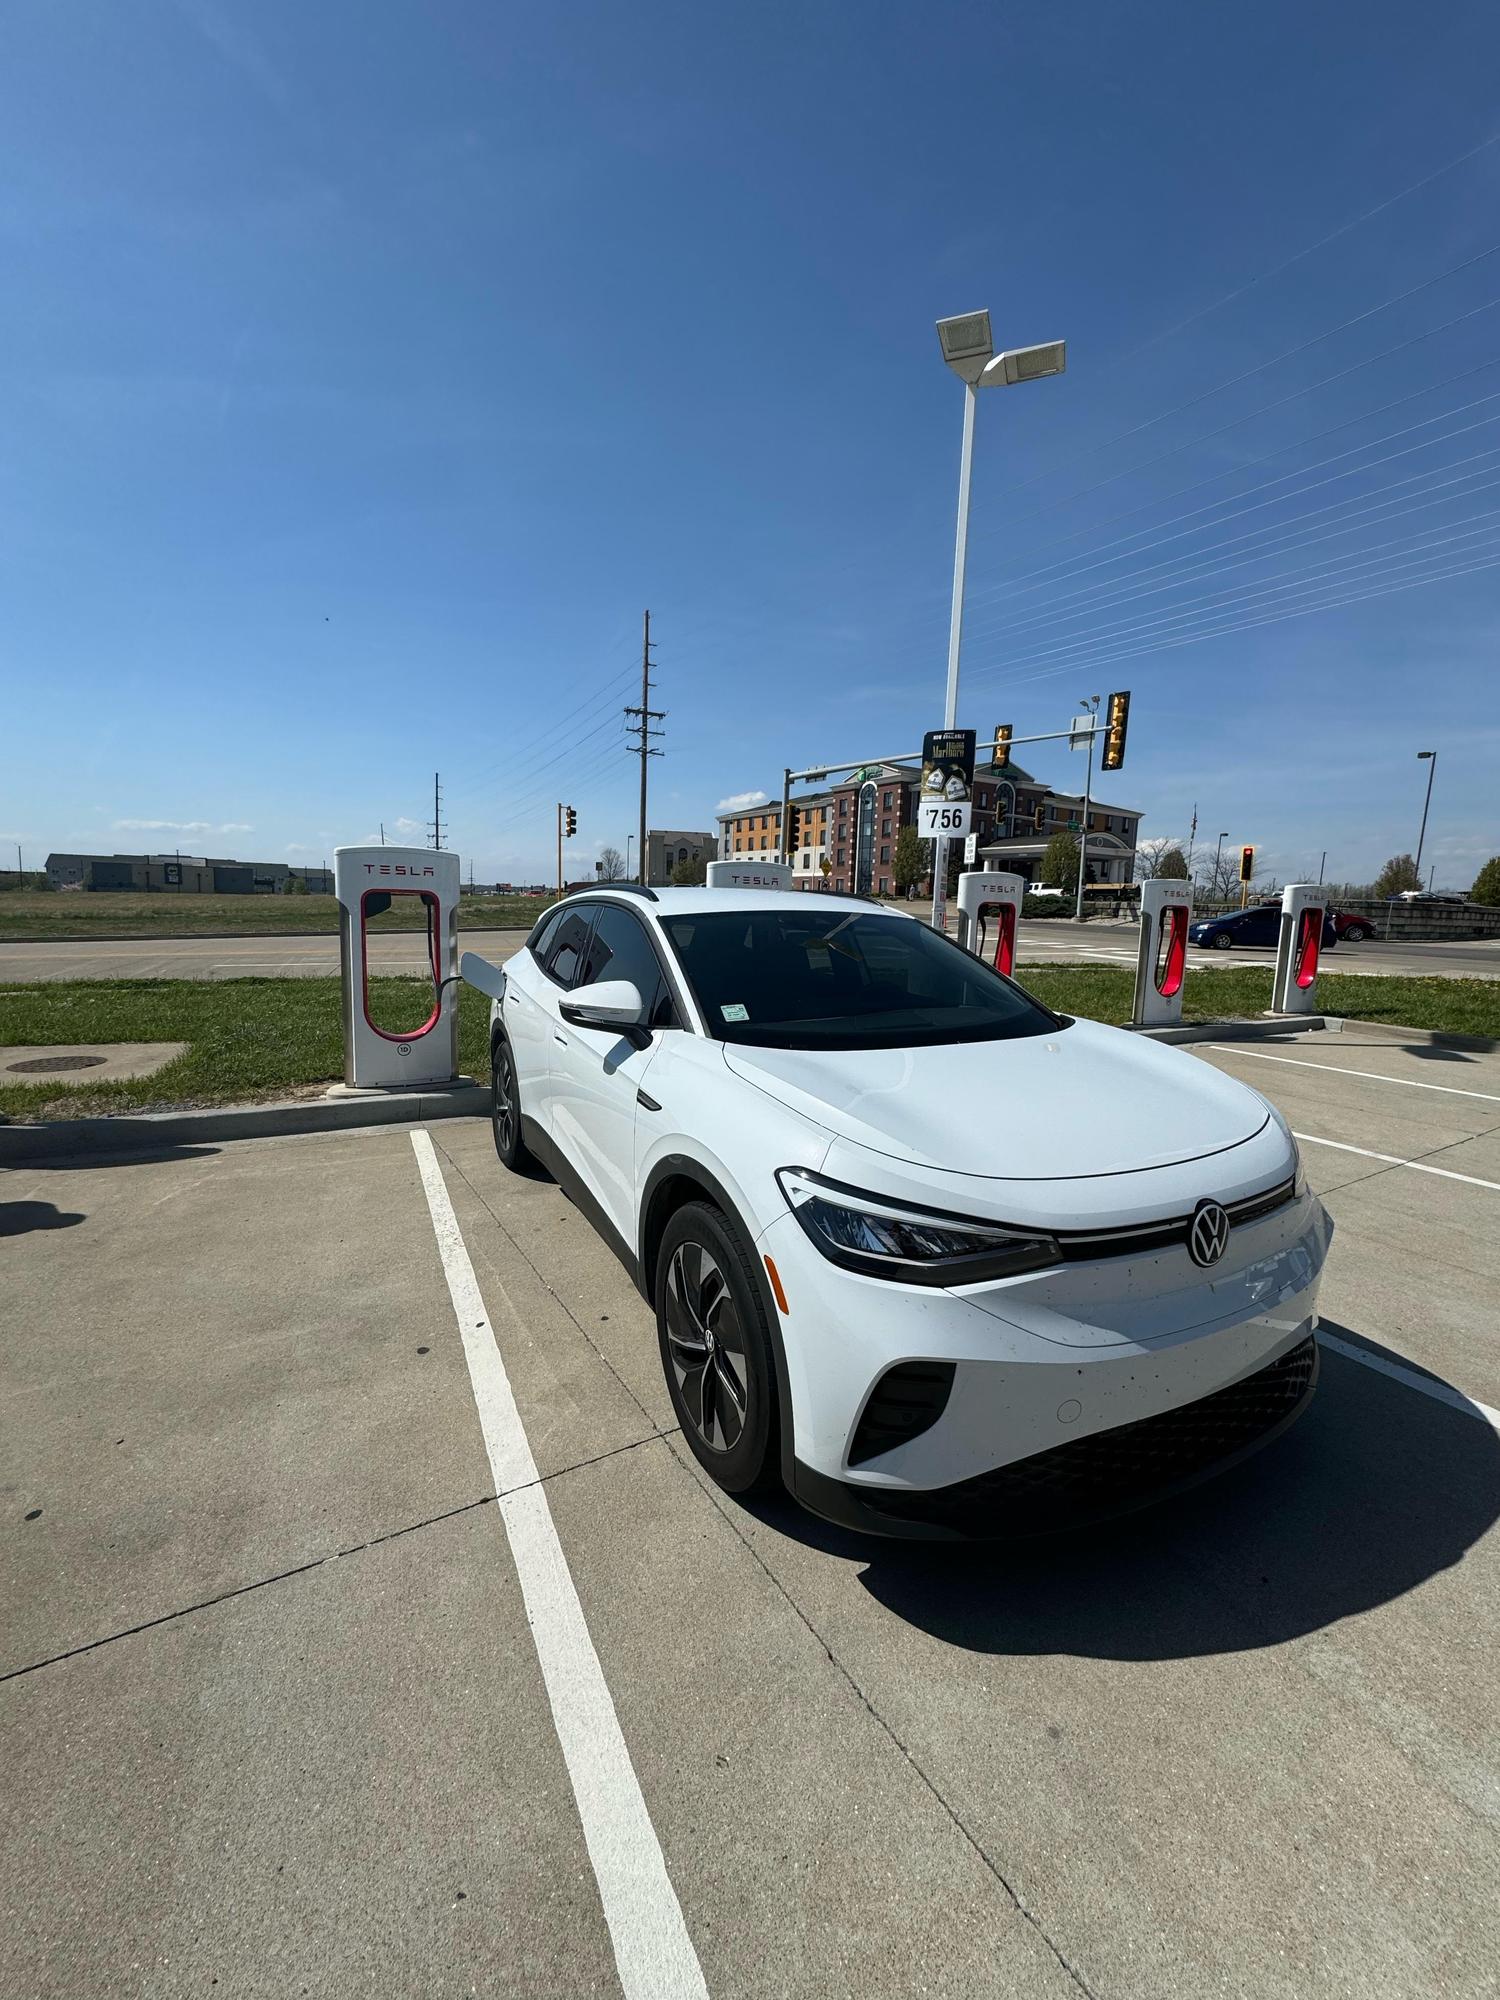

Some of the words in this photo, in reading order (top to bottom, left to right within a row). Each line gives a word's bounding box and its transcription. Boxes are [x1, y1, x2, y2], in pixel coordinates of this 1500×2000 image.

[363, 864, 434, 877] TESLA
[731, 875, 779, 886] TESLA
[981, 884, 1016, 893] TESLA
